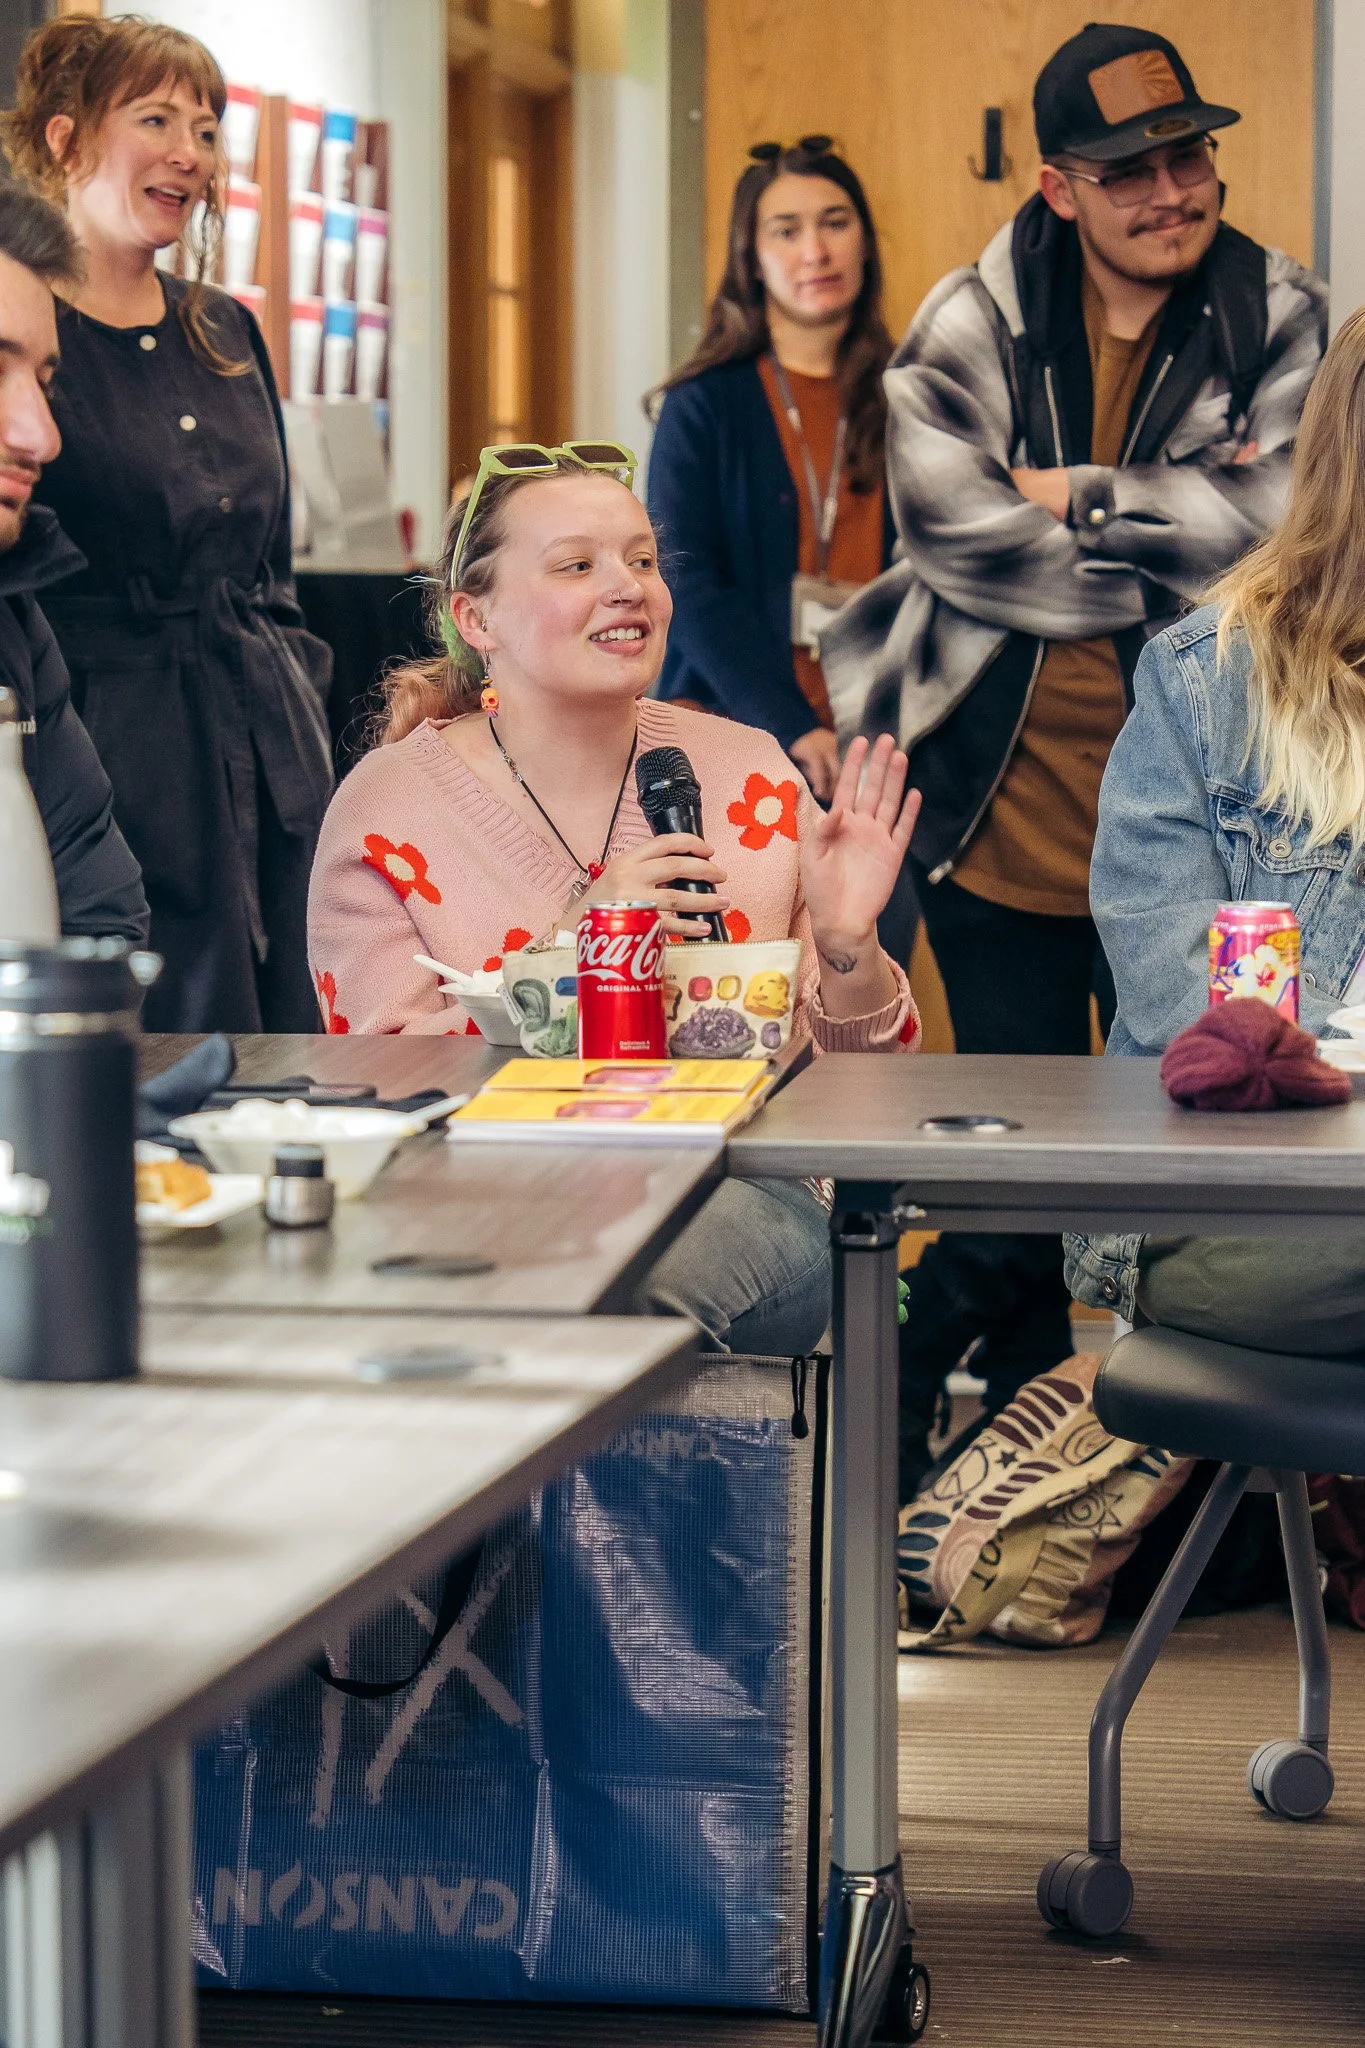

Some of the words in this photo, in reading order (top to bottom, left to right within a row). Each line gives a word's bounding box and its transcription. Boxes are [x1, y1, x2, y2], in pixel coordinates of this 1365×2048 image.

[596, 984, 642, 992] ORIGINAL
[644, 984, 664, 992] TAST
[212, 1862, 519, 1939] CANSON
